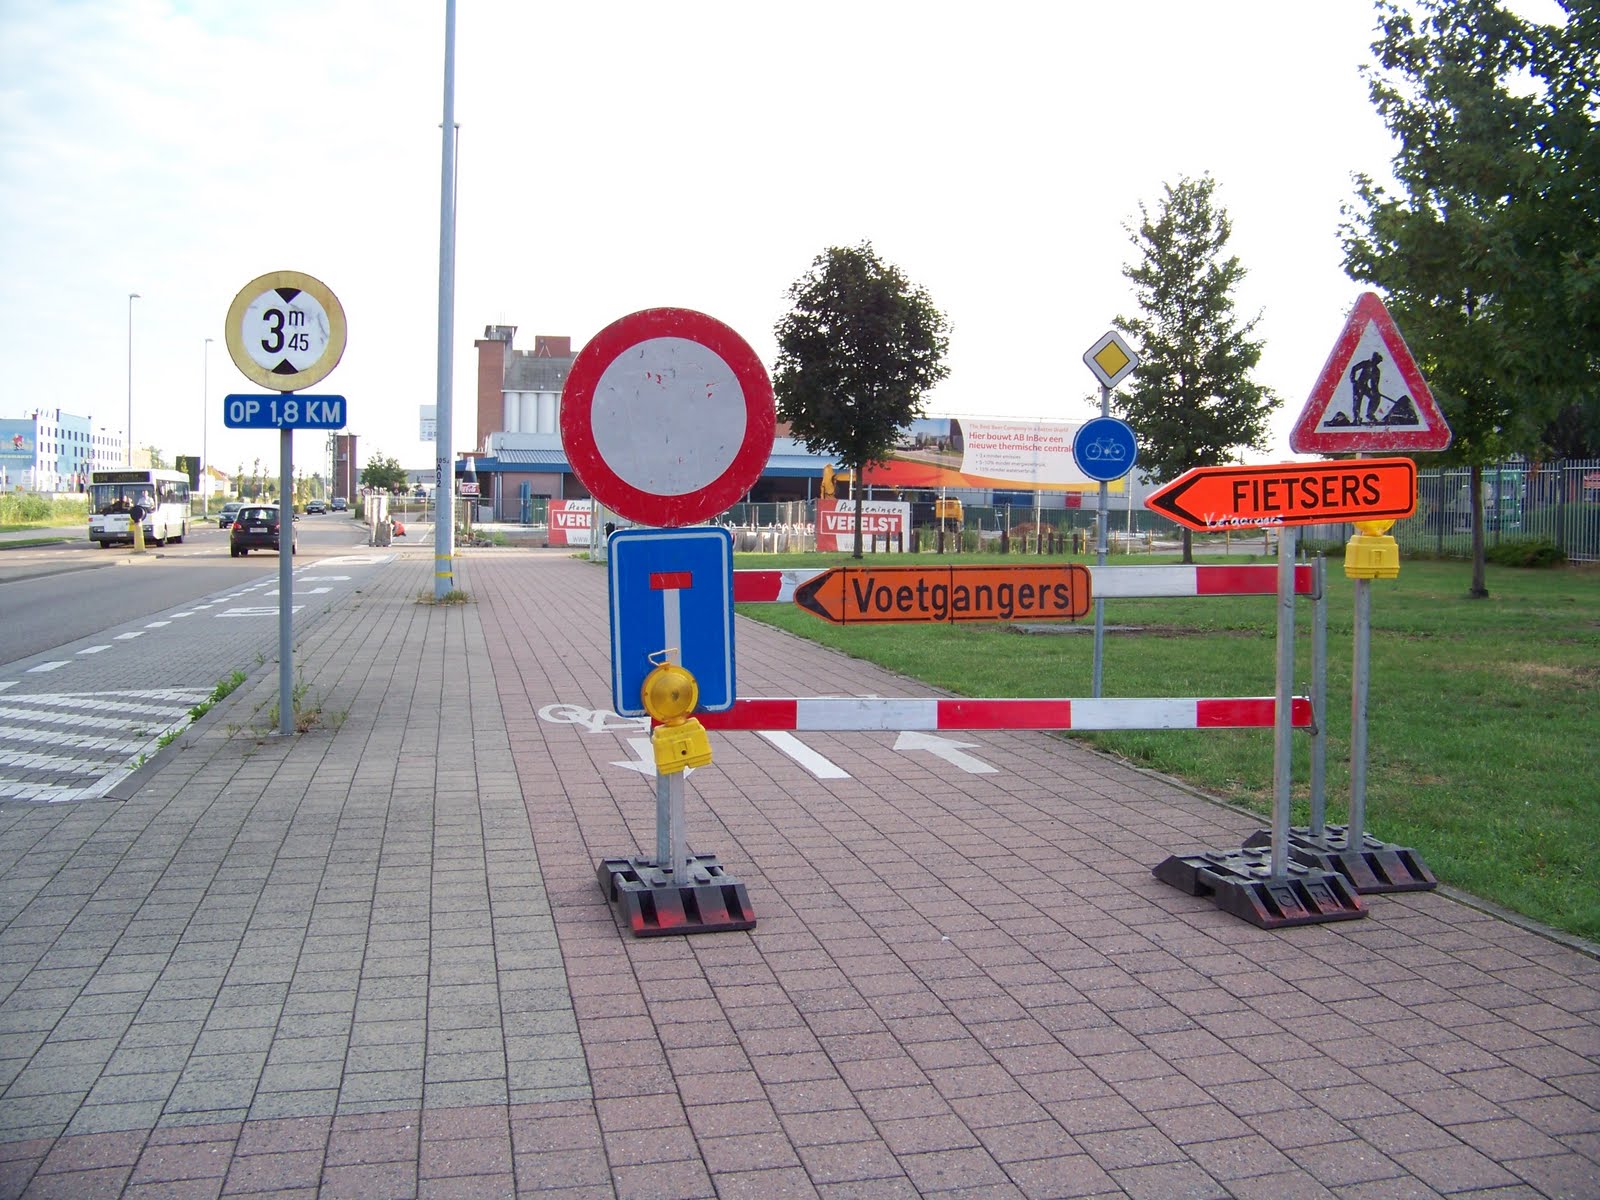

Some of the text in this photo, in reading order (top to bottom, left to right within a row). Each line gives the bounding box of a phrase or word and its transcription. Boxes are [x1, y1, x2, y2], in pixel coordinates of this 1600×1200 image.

[261, 308, 305, 354] 3 m
[288, 333, 309, 352] 45
[230, 401, 341, 426] OP 1,8 KM
[968, 432, 985, 440] Hier
[986, 432, 1012, 441] bouwt
[1013, 433, 1025, 442] AB
[1026, 434, 1048, 442] InBev
[968, 441, 1073, 453] nieuwe thermische central
[1232, 473, 1381, 513] FIETSERS
[839, 501, 903, 514] Aanemingen
[825, 515, 899, 532] VERELST
[852, 577, 1069, 621] Voetgangers
